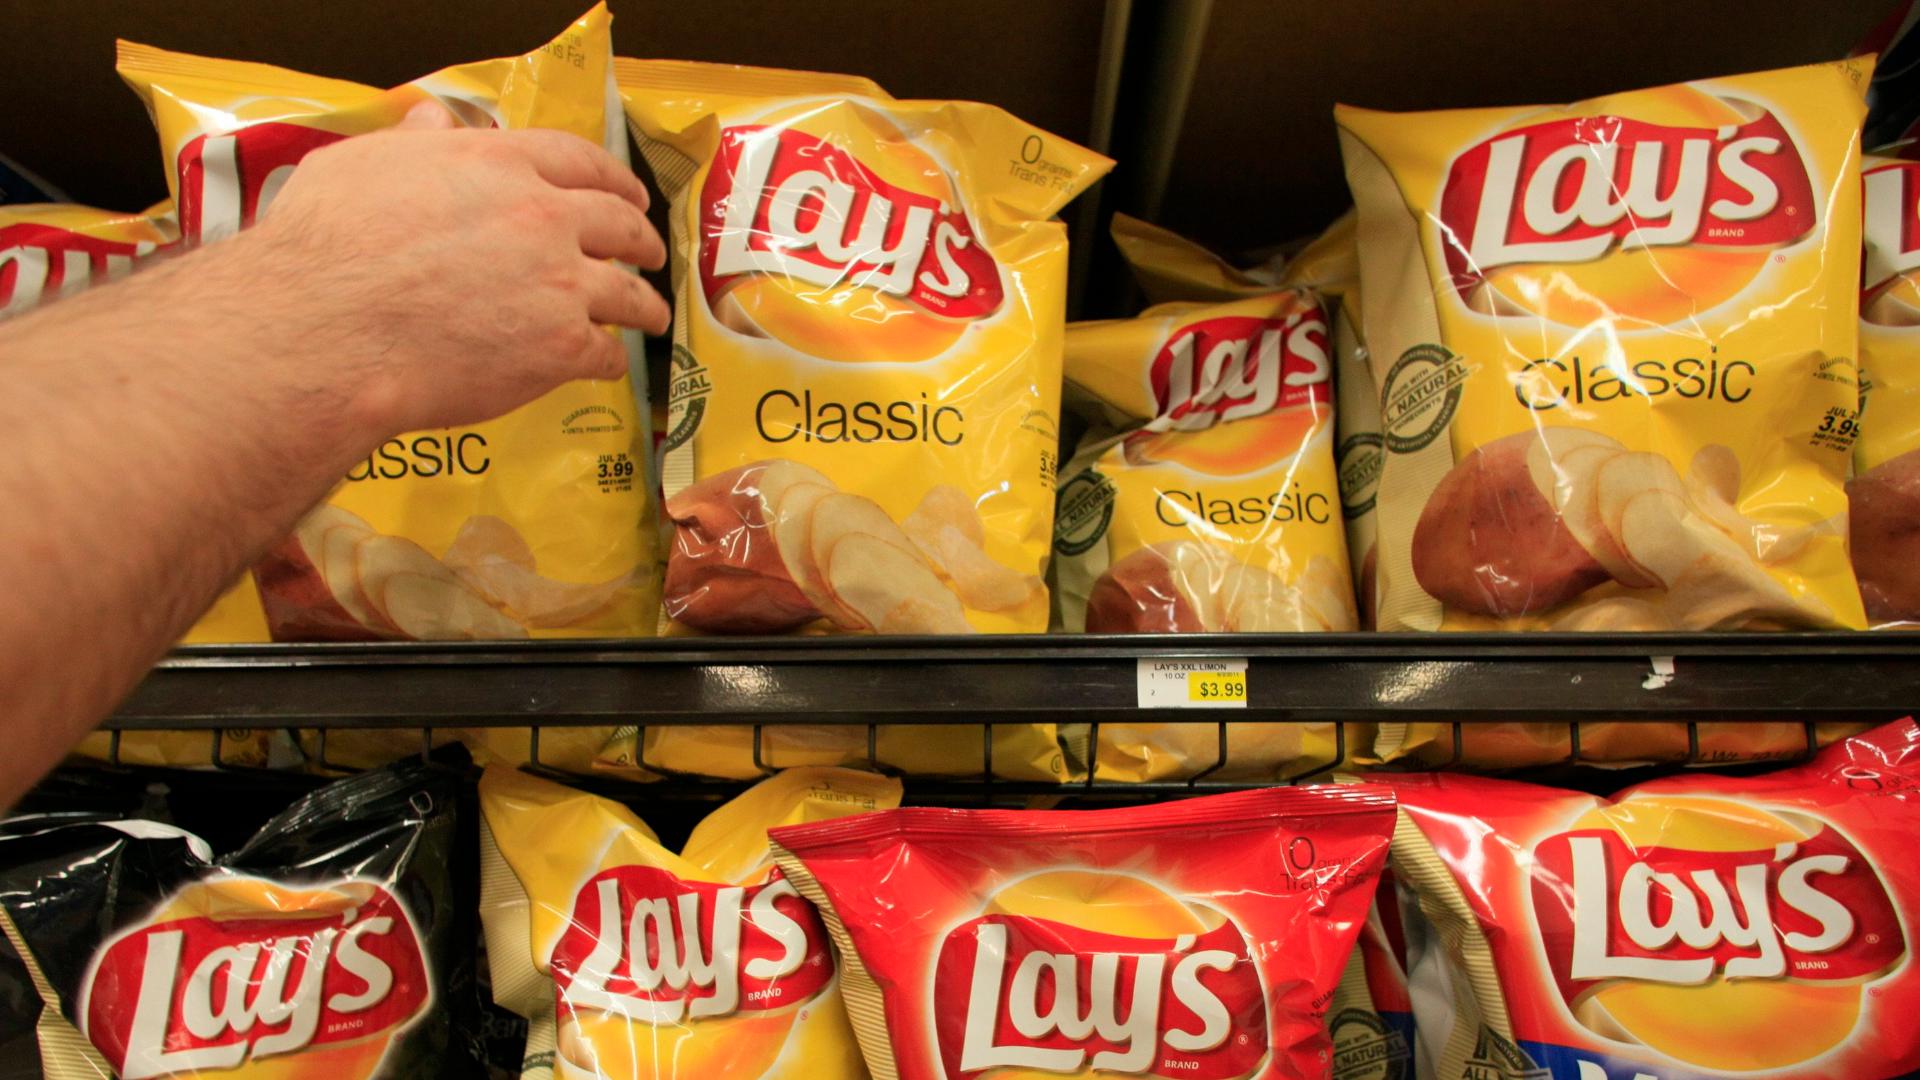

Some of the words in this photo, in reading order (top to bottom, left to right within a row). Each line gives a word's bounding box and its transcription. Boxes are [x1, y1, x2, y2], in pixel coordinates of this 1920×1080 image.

[1021, 134, 1044, 165] 0
[1008, 159, 1047, 187] Trans
[713, 128, 971, 297] Lay's
[1466, 125, 1781, 272] Lay's
[1707, 226, 1745, 238] BRAND
[919, 290, 949, 308] BRAND
[671, 374, 711, 398] URAL
[1150, 313, 1330, 429] Lay's
[1397, 364, 1468, 415] NATURAL
[1515, 342, 1756, 410] Classic
[755, 390, 964, 446] Classic
[345, 425, 490, 482] assic
[598, 462, 633, 478] 3.99
[1156, 482, 1329, 527] Classic
[1200, 682, 1244, 697] $3.99
[1289, 836, 1315, 870] 0
[1570, 837, 1855, 984] Lay's
[560, 876, 808, 1027] Lays
[1795, 960, 1829, 972] BRAND
[121, 906, 394, 1080] Lay's
[748, 987, 782, 1001] BRAND
[960, 922, 1237, 1073] Lay's
[327, 1018, 364, 1034] BRAND
[1164, 1059, 1200, 1071] BRAND
